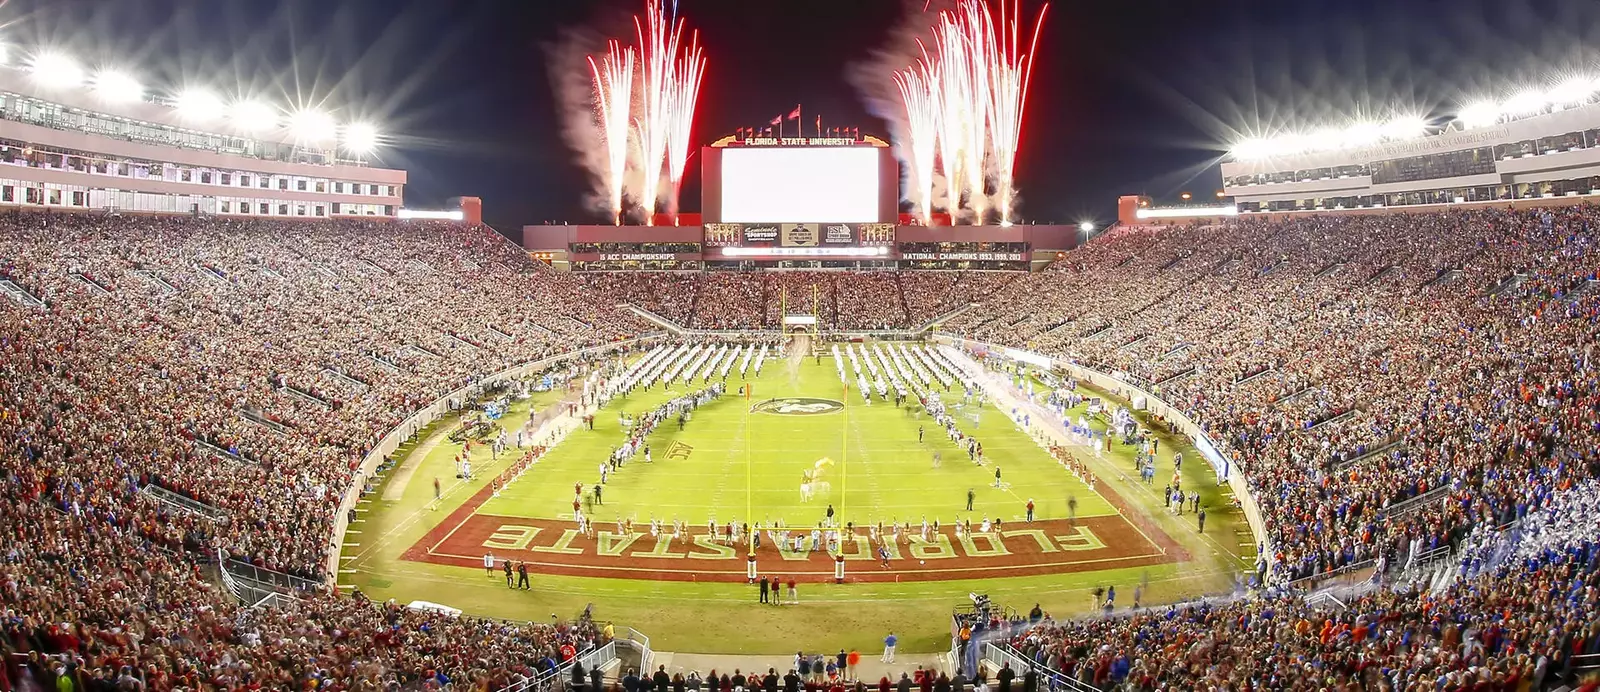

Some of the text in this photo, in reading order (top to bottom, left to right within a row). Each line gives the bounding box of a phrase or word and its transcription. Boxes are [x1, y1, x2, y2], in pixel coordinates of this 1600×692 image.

[745, 138, 855, 146] FLORIDA STATE UNIVERSITY
[481, 524, 1108, 561] FLORIDA STATE
